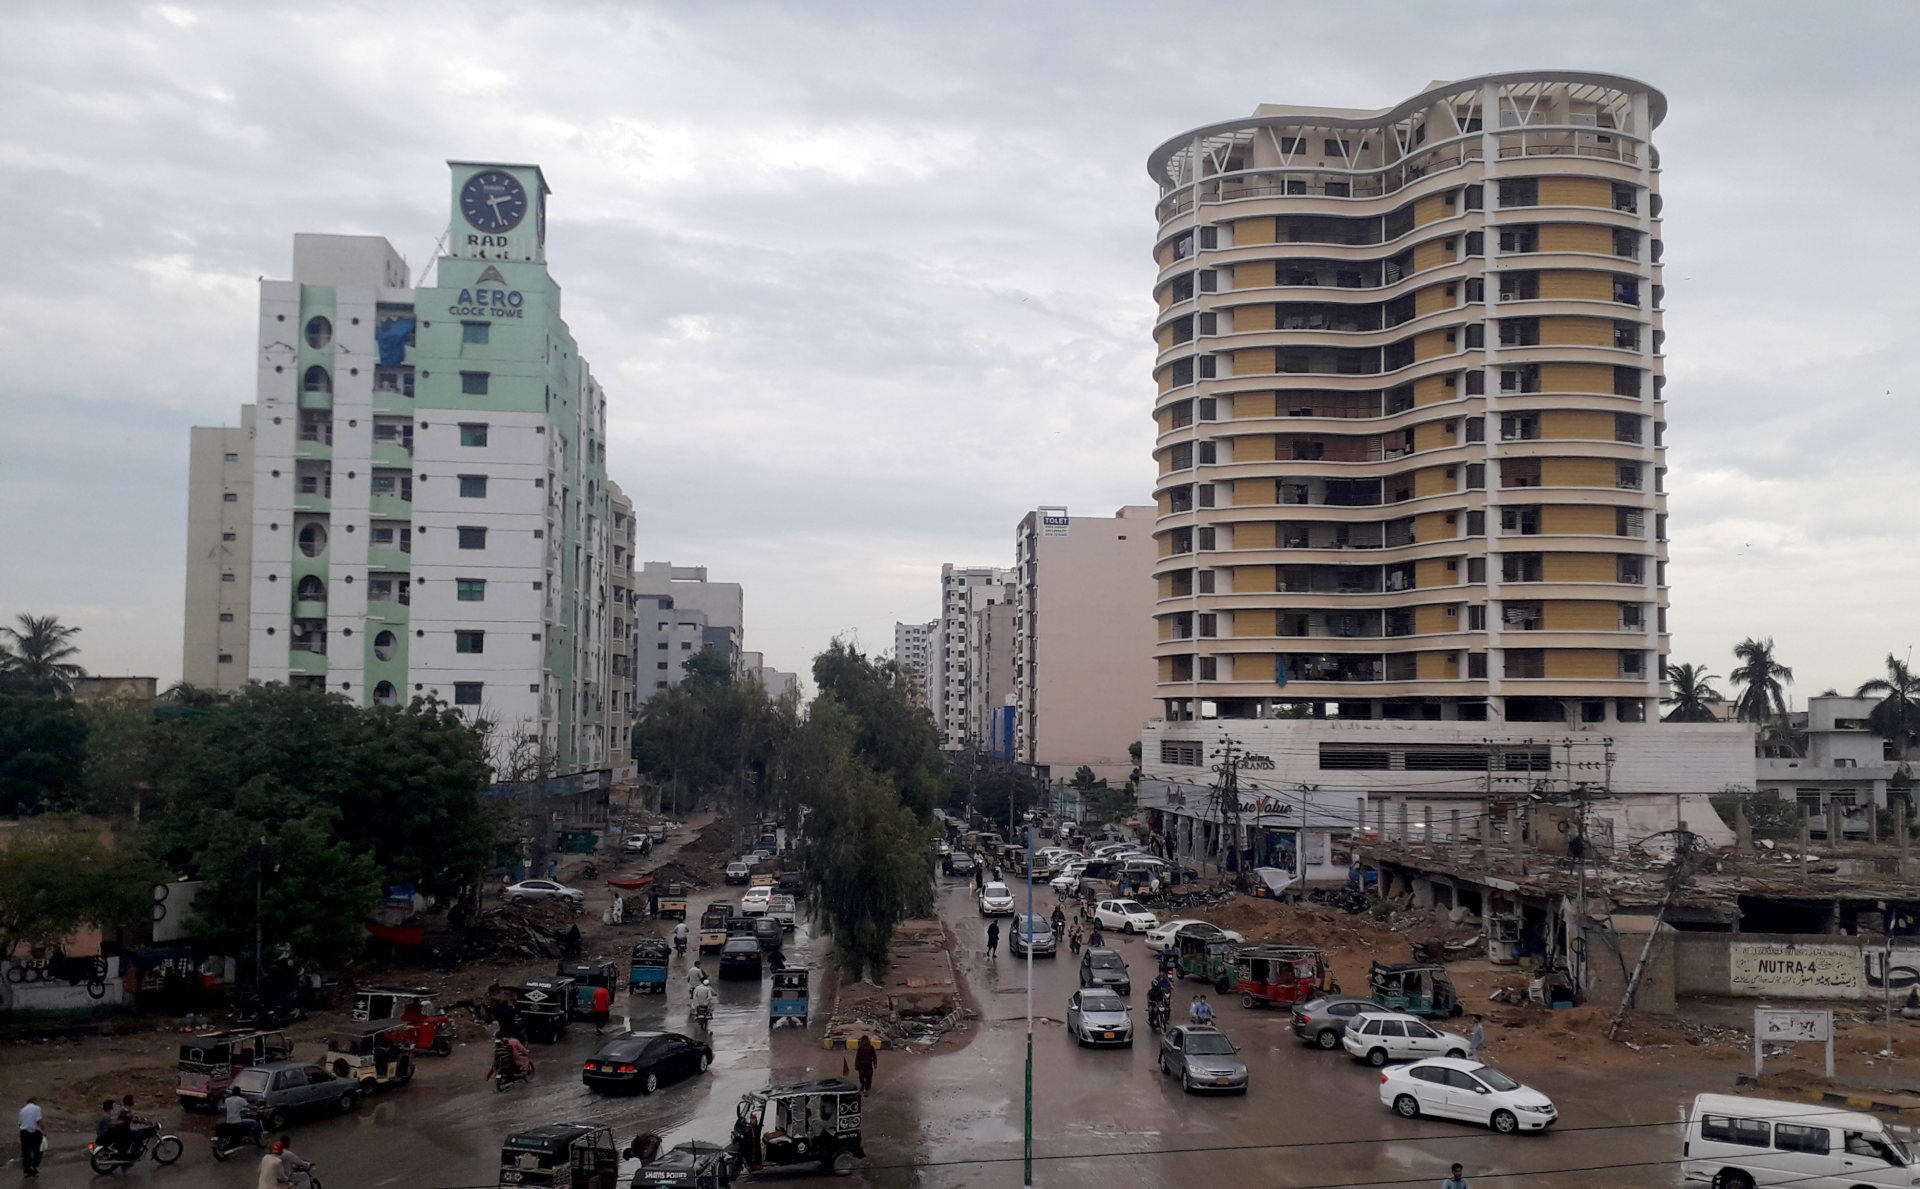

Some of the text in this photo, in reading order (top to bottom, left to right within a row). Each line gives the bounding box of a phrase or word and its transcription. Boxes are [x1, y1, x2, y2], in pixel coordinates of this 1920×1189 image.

[467, 234, 508, 247] RAD
[458, 288, 523, 308] AERO
[448, 306, 523, 318] CLOCK TOWE
[1236, 760, 1275, 770] GRANDS
[1758, 959, 1817, 974] NUTRA-4
